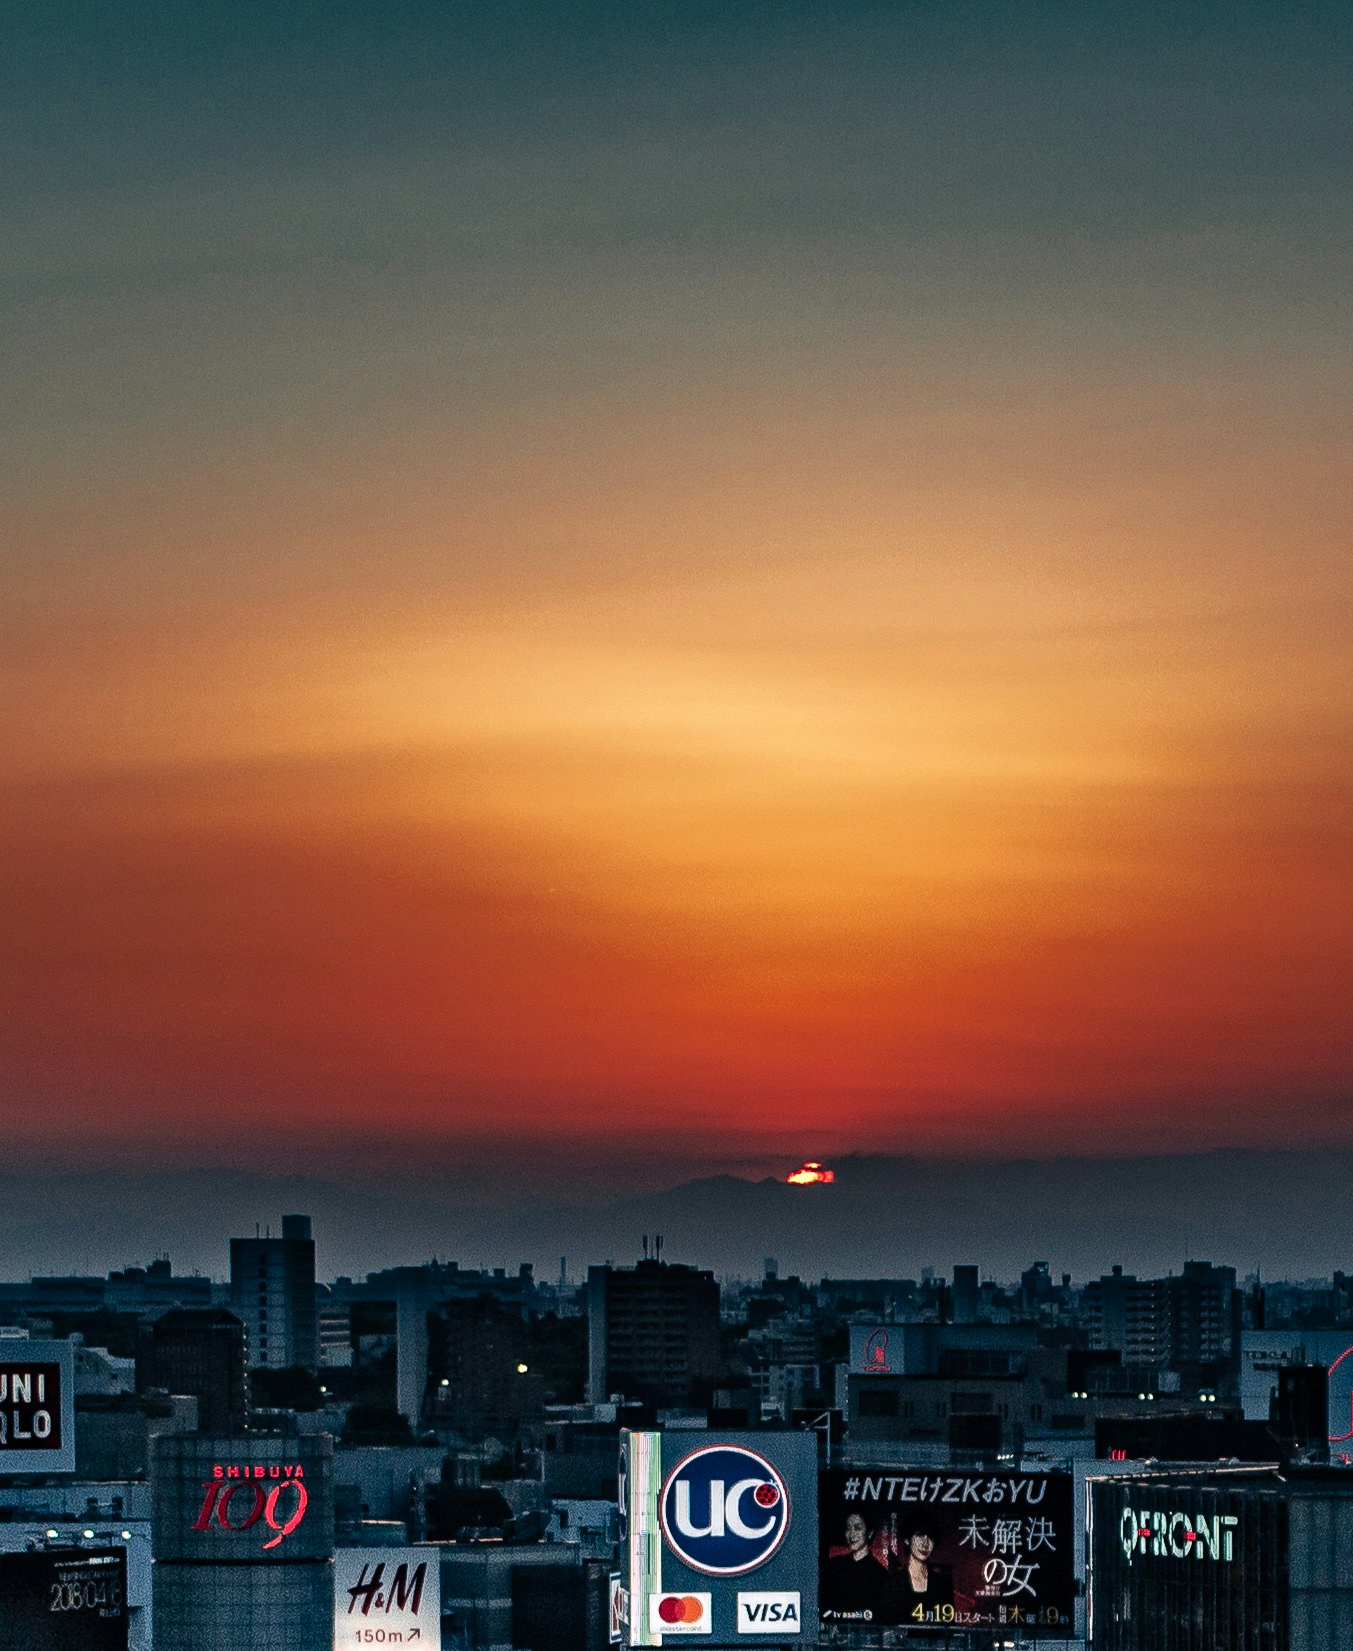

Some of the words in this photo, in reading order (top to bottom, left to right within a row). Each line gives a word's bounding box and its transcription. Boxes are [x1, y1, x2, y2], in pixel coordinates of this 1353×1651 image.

[212, 1464, 305, 1479] SHIBUYA
[190, 1478, 309, 1551] 109
[958, 1513, 1057, 1554] 未解決
[1120, 1507, 1238, 1565] QFRONT
[347, 1561, 428, 1617] H&M
[983, 1554, 1041, 1598] の女
[743, 1602, 799, 1623] VISA
[355, 1629, 404, 1644] 150m
